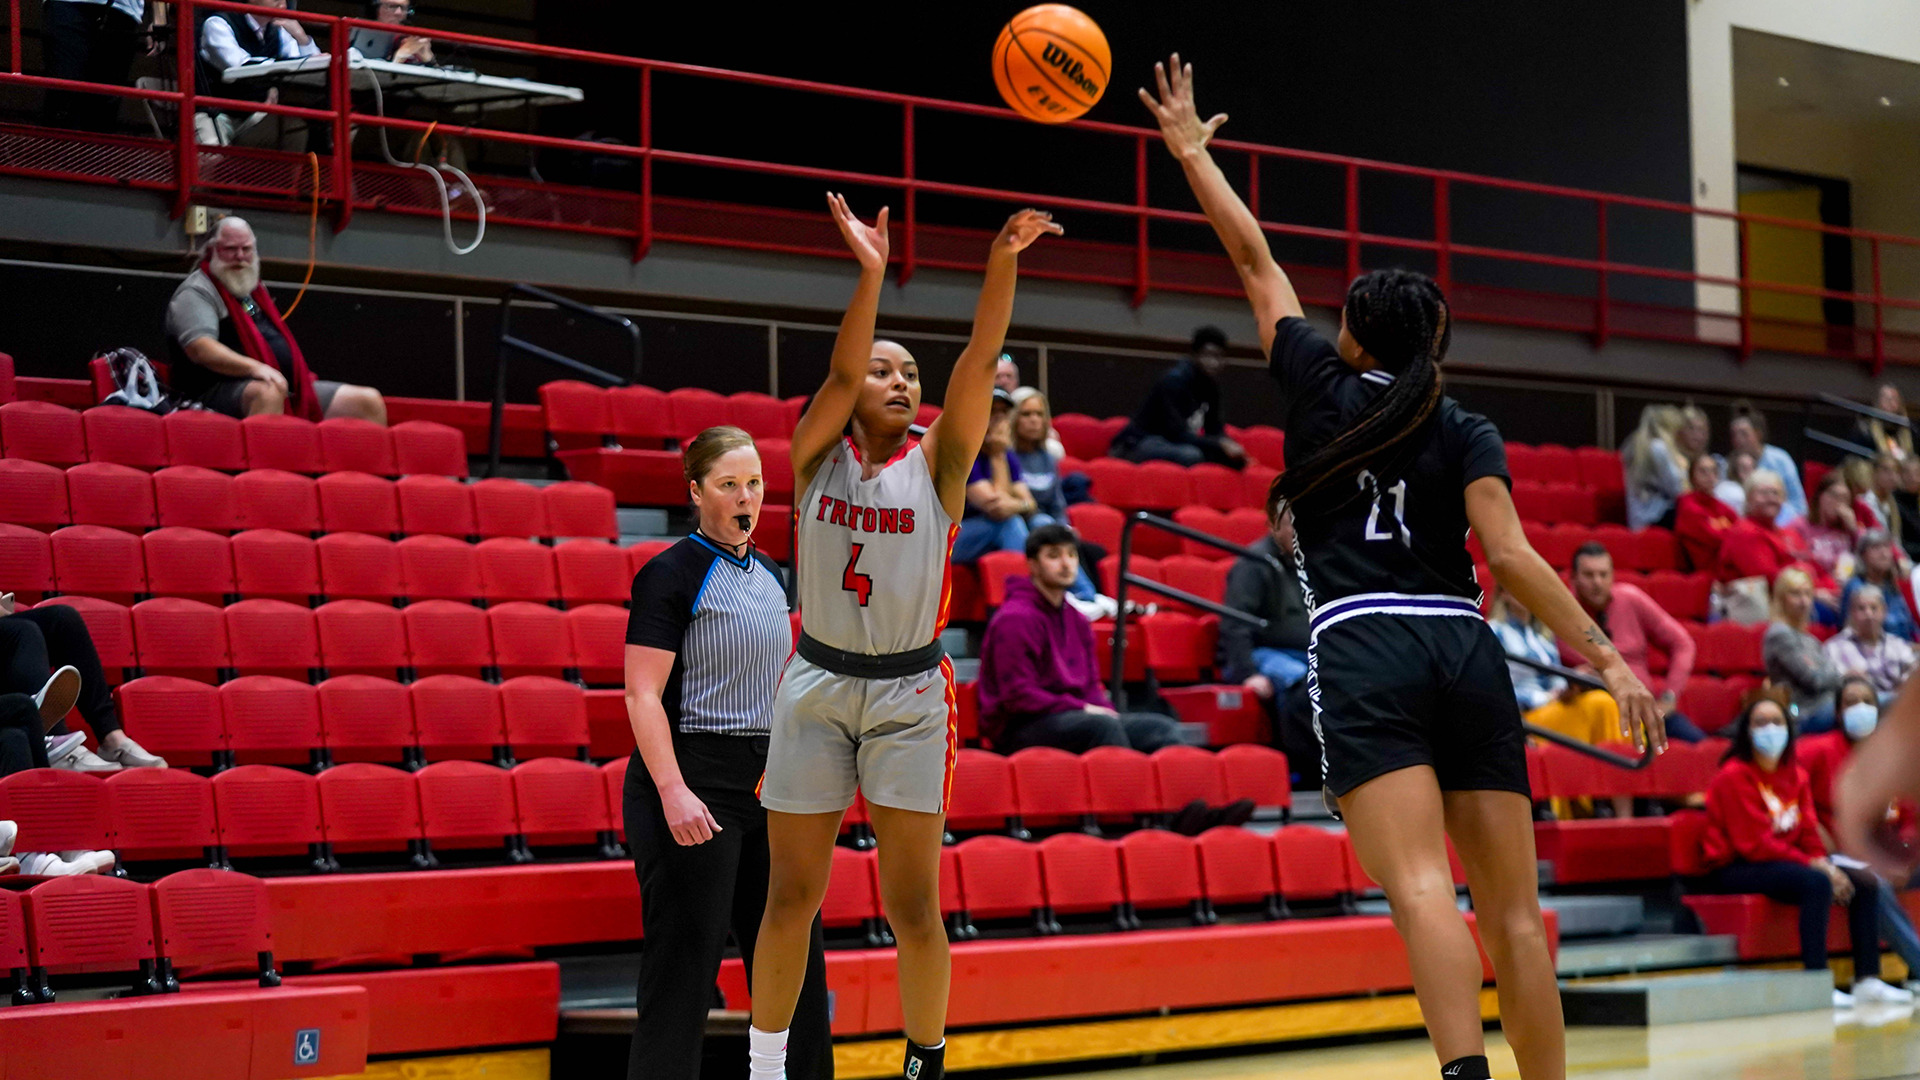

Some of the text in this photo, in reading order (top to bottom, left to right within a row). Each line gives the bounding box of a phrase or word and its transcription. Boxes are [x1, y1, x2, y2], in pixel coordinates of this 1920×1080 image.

[1042, 41, 1099, 98] Wilson
[816, 494, 915, 534] TRTONS
[1356, 469, 1411, 549] 21
[842, 542, 873, 607] 4
